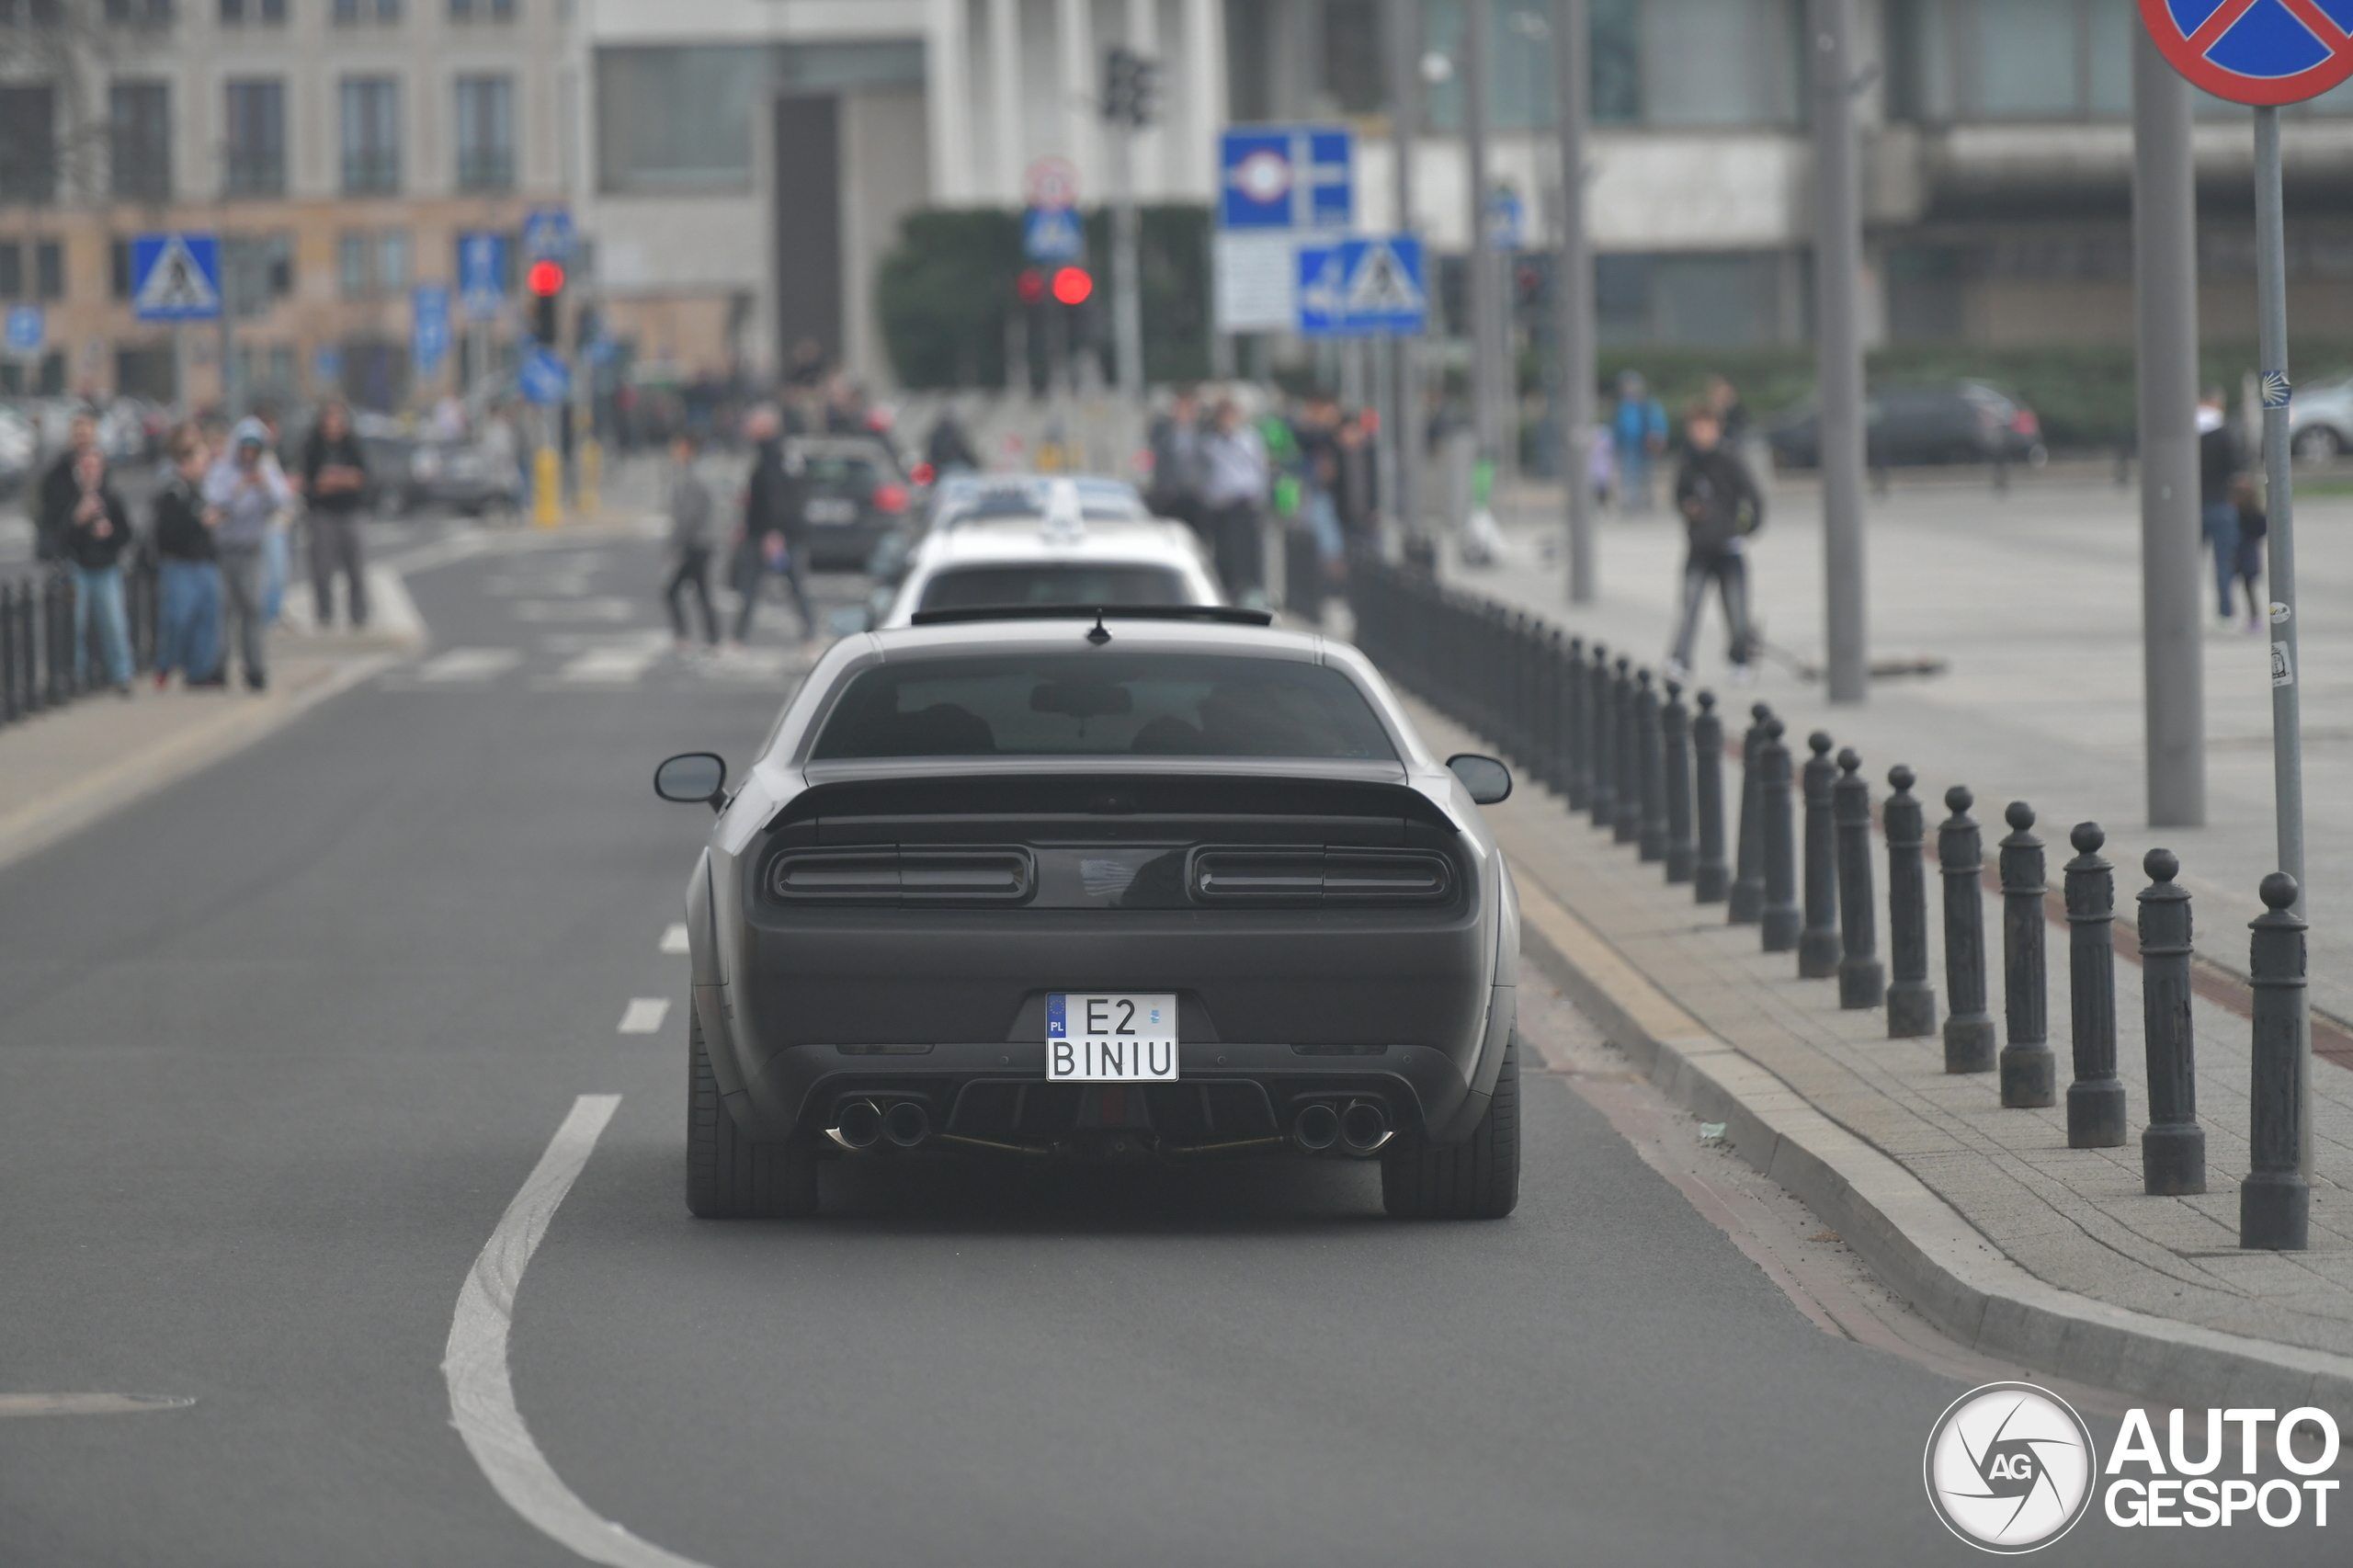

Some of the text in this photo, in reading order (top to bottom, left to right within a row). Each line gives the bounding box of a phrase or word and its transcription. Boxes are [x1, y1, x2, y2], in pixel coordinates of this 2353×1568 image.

[1051, 1022, 1064, 1031] PL
[1086, 999, 1135, 1035] E2
[1053, 1041, 1170, 1076] BINIU
